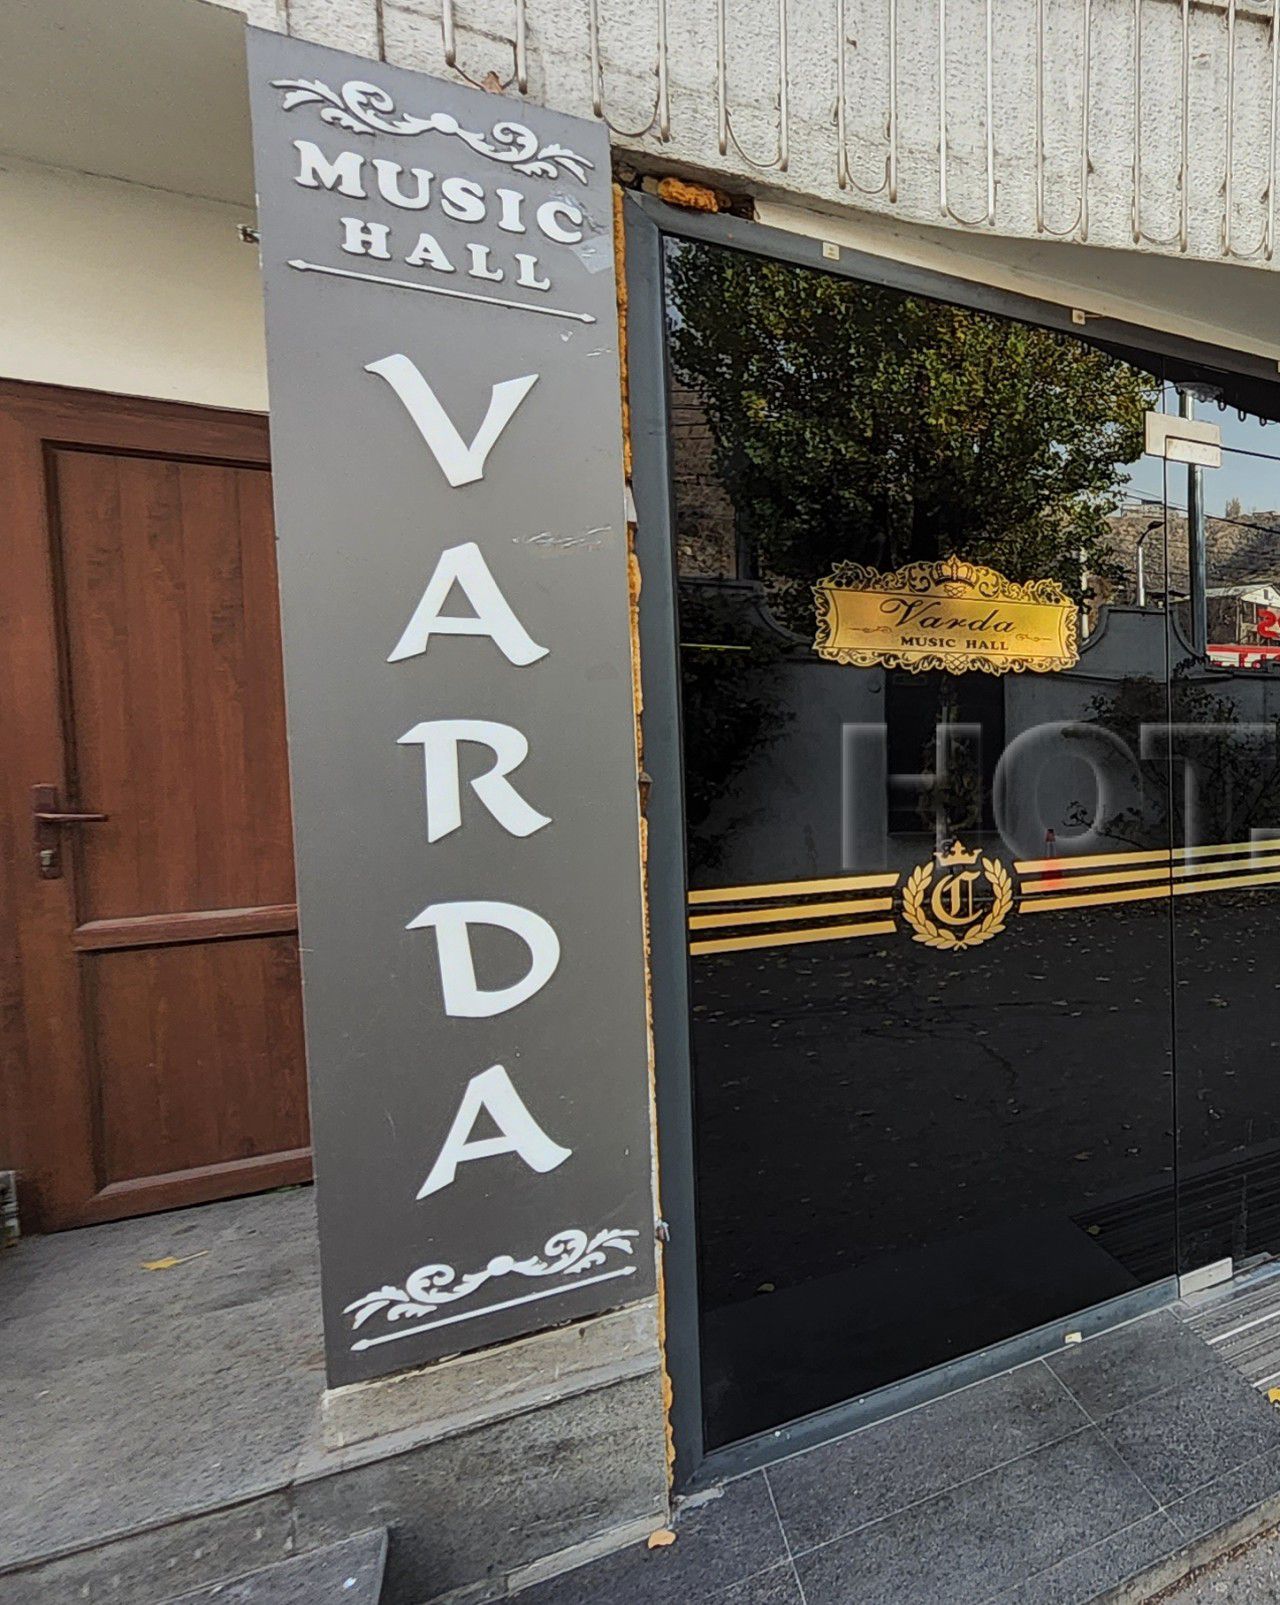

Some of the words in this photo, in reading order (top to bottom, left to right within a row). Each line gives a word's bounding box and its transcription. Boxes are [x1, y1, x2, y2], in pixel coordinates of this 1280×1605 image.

[292, 138, 584, 245] MUSIC
[339, 216, 551, 292] HALL
[879, 597, 1017, 634] Varda
[900, 635, 957, 649] MUSIC
[965, 638, 1009, 651] HALL
[364, 352, 573, 1201] VARDA
